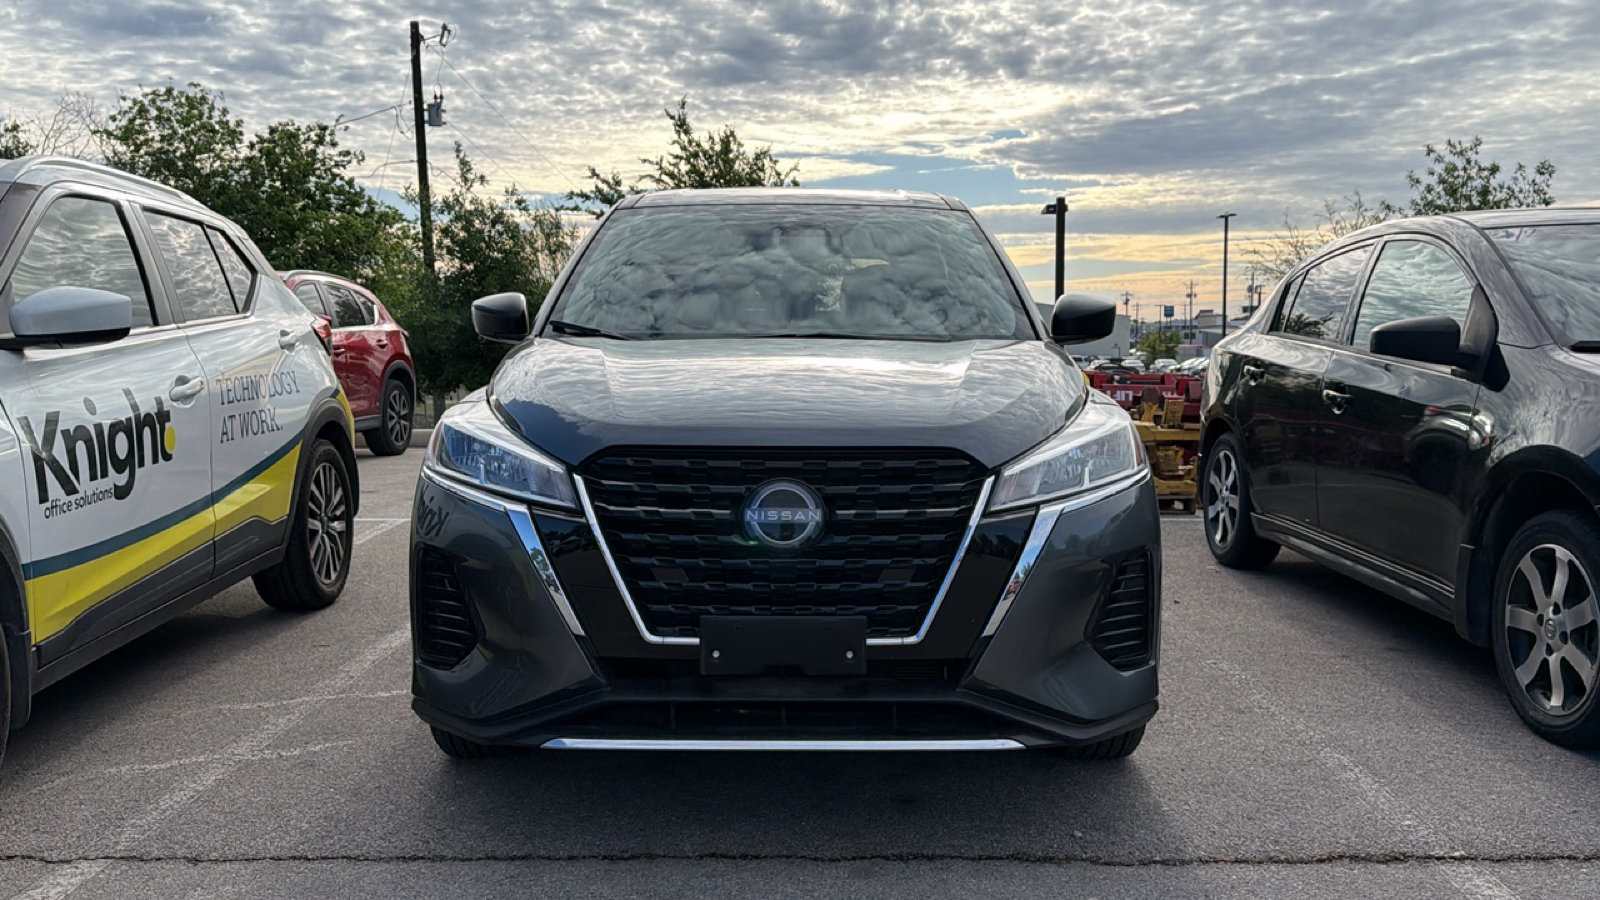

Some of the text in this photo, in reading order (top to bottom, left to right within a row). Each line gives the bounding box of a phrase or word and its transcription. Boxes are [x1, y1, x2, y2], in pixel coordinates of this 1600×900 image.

[216, 370, 300, 405] TECHNOLOGY
[220, 407, 283, 443] AT WORK.
[16, 387, 174, 505] Knight
[44, 487, 113, 519] office solutions
[747, 510, 820, 521] NISSAN
